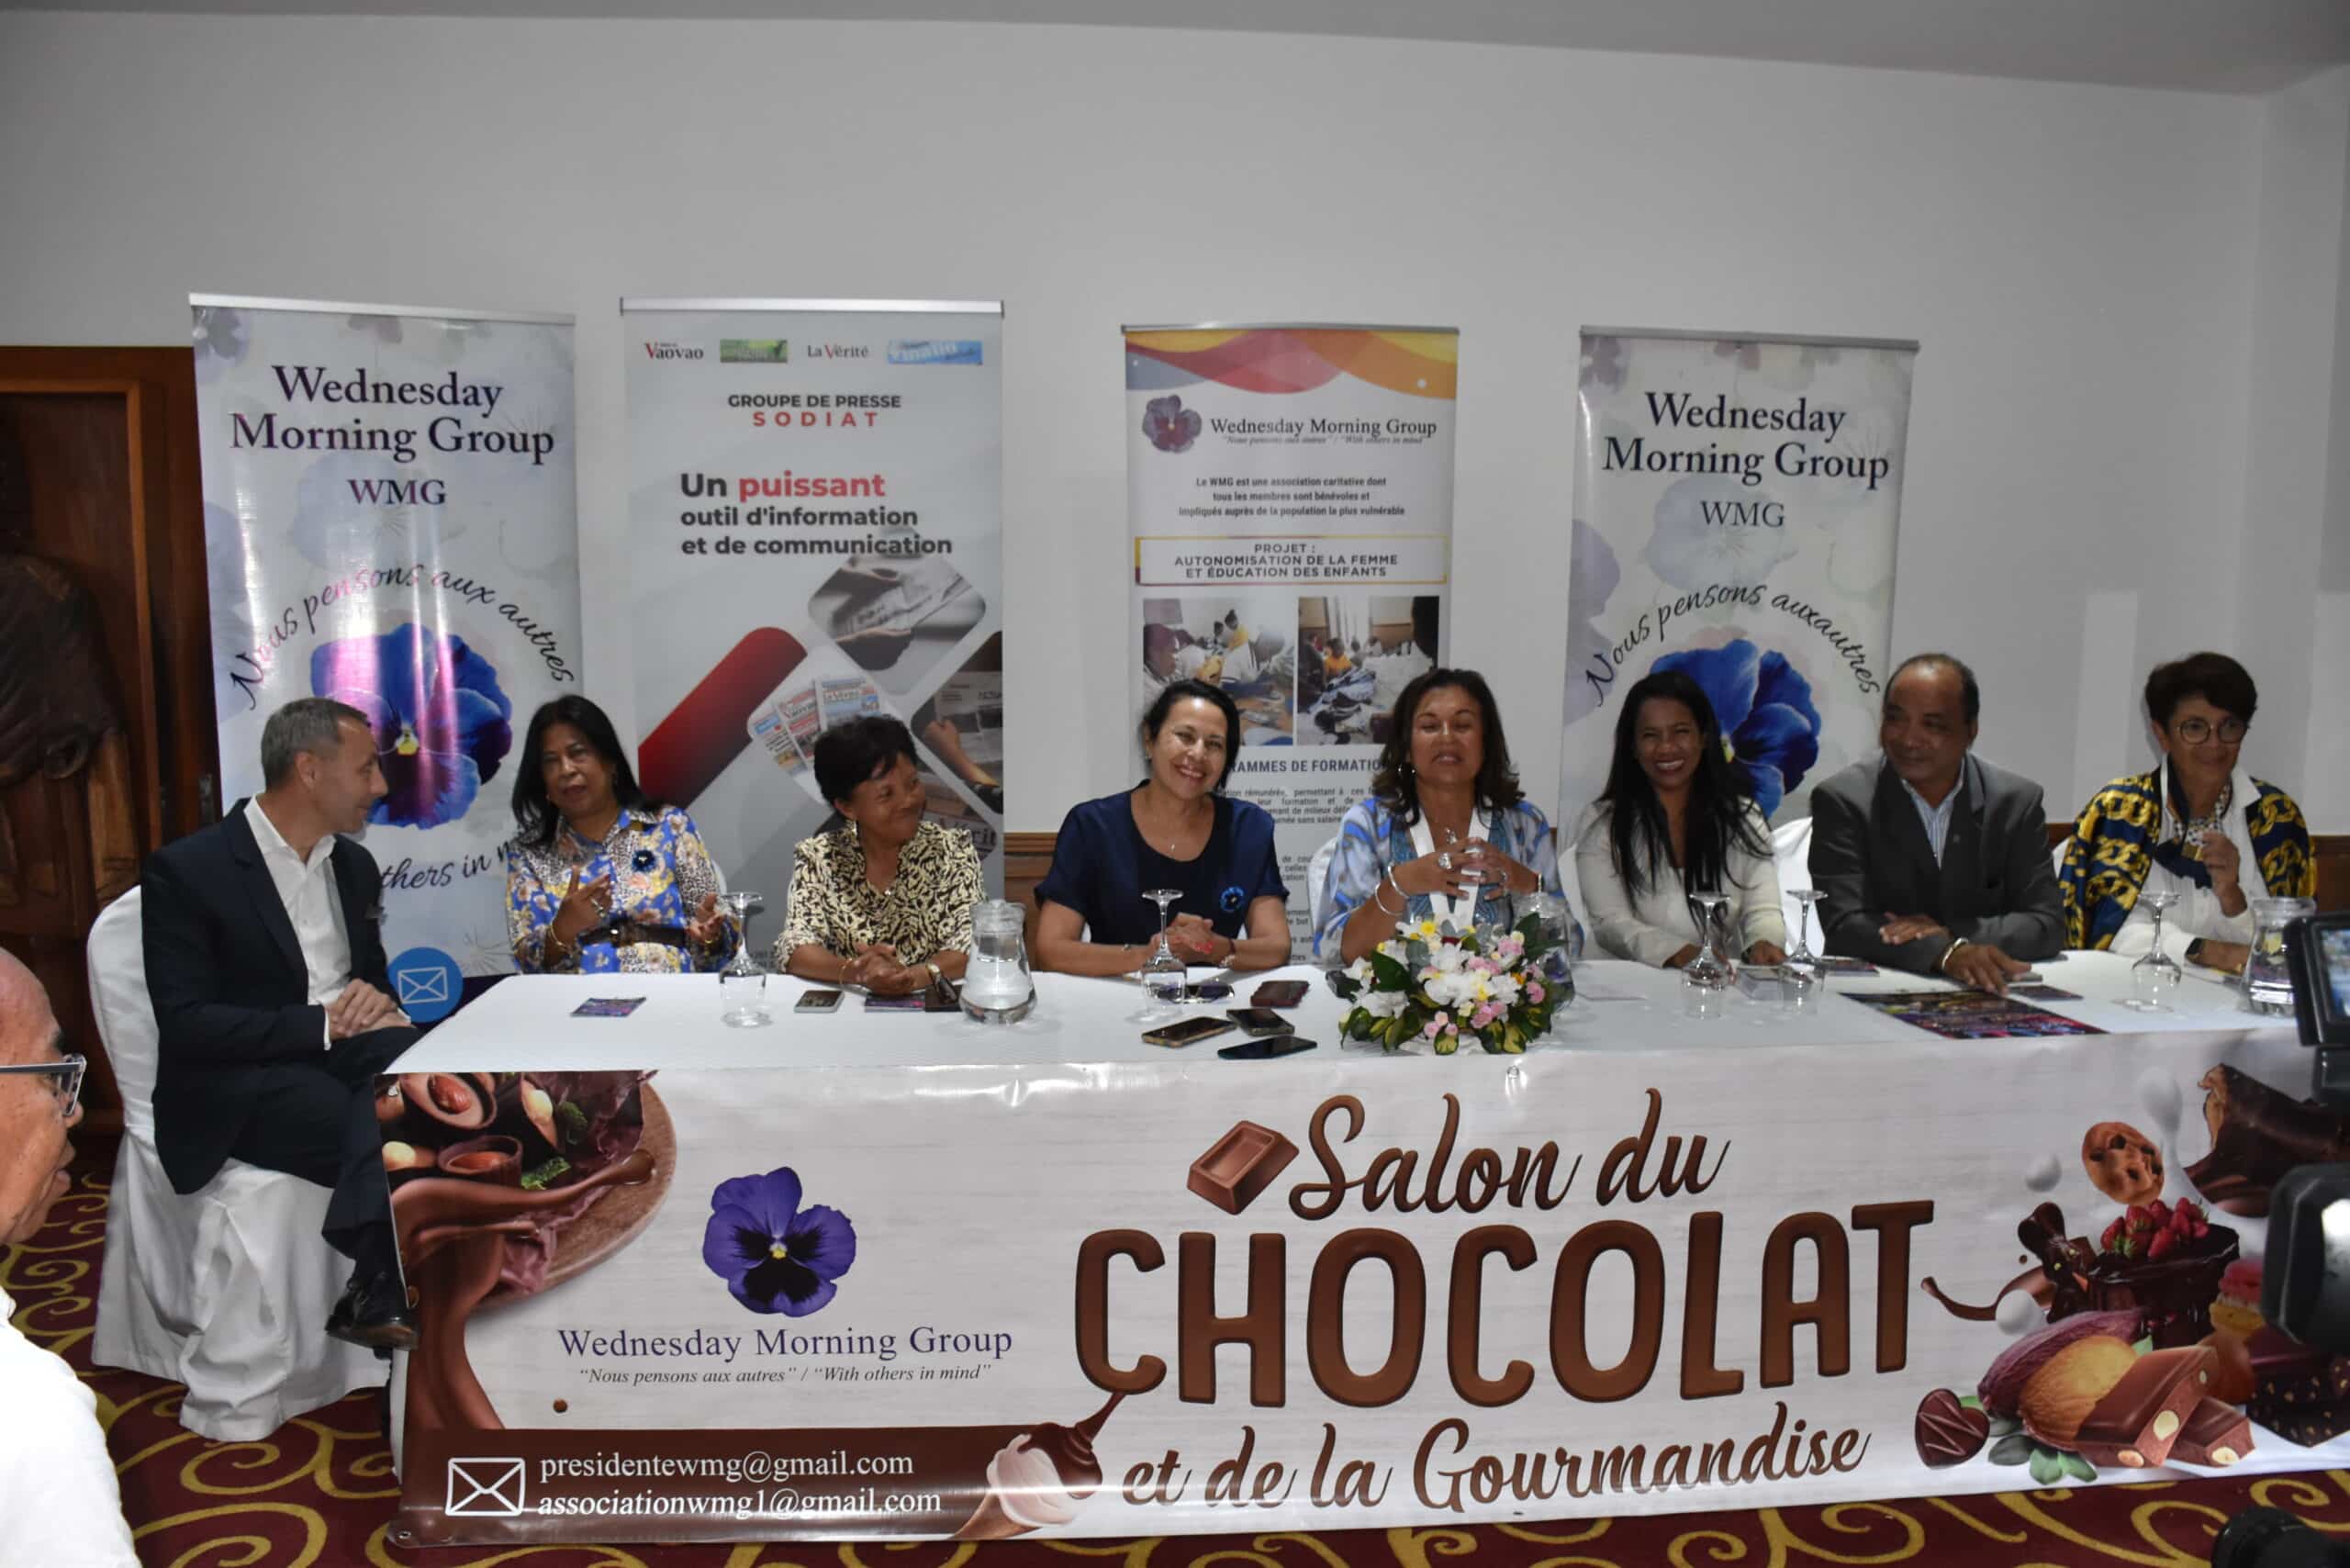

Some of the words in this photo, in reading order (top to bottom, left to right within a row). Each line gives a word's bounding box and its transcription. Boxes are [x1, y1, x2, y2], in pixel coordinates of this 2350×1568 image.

[643, 342, 704, 361] Vaovao
[808, 344, 822, 358] La
[272, 365, 504, 418] Wednesday
[728, 394, 801, 409] GROUPE
[807, 395, 830, 408] DE
[835, 395, 902, 409] PRESSE
[752, 410, 879, 428] SODIAT
[1210, 419, 1304, 437] Wednesday
[1310, 419, 1382, 438] Morning
[1386, 419, 1437, 438] Group
[1645, 392, 1847, 442] Wednesday
[229, 412, 418, 464] Morning
[428, 417, 554, 465] Group
[1602, 436, 1763, 485] Morning
[1774, 442, 1889, 490] Group
[348, 478, 447, 506] WMG
[680, 472, 727, 498] Un
[739, 470, 886, 503] puissant
[1210, 477, 1234, 486] WMG
[1237, 477, 1249, 486] est
[1270, 477, 1321, 486] association
[1323, 477, 1365, 486] caritative
[1367, 477, 1386, 486] dont
[1213, 492, 1232, 500] tous
[1235, 492, 1248, 500] les
[1249, 492, 1291, 500] membres
[1293, 492, 1313, 500] sont
[1315, 491, 1359, 500] bénévoles
[1360, 492, 1370, 500] et
[680, 506, 739, 527] outil
[746, 506, 918, 527] d'information
[1179, 506, 1222, 518] impliqués
[1225, 507, 1254, 517] auprès
[1256, 506, 1267, 515] de
[1270, 506, 1278, 515] la
[1281, 506, 1326, 517] population
[1329, 506, 1337, 515] la
[1339, 506, 1358, 517] plus
[1360, 506, 1404, 515] vulnérable
[1700, 501, 1785, 528] WMG
[681, 537, 709, 554] et
[714, 535, 746, 554] de
[754, 535, 953, 555] communication
[1254, 543, 1307, 554] PROJET
[1174, 554, 1301, 566] AUTONOMISATION
[1306, 554, 1325, 566] DE
[1329, 554, 1346, 566] LA
[1351, 554, 1398, 566] FEMME
[1186, 567, 1203, 578] ET
[1207, 566, 1287, 578] ÉDUCATION
[1293, 566, 1319, 577] DES
[1324, 566, 1387, 577] ENFANTS
[229, 607, 298, 711] Nous
[304, 564, 424, 633] pensons
[431, 570, 496, 605] aux
[498, 603, 574, 681] autres
[1585, 614, 1651, 707] Nous
[1657, 584, 1767, 642] pensons
[1292, 760, 1307, 772] DE
[1312, 759, 1382, 772] FORMATIO
[381, 857, 454, 889] thers
[463, 855, 492, 879] in
[1289, 1092, 1583, 1221] Salon
[1595, 1088, 1731, 1205] du
[1075, 1199, 1935, 1408] CHOCOLAT
[558, 1328, 742, 1362] Wednesday
[756, 1327, 896, 1360] Morning
[909, 1326, 1013, 1359] Group
[633, 1370, 698, 1387] pensons
[702, 1370, 732, 1383] aux
[864, 1365, 914, 1383] others
[920, 1366, 935, 1381] in
[539, 1450, 913, 1484] presidentewmg@gmail.com
[1122, 1450, 1192, 1507] et
[1206, 1426, 1294, 1507] de
[1310, 1422, 1393, 1507] la
[1413, 1402, 1872, 1513] Gourmandise
[538, 1487, 942, 1520] associationwmg1@gmail.com
